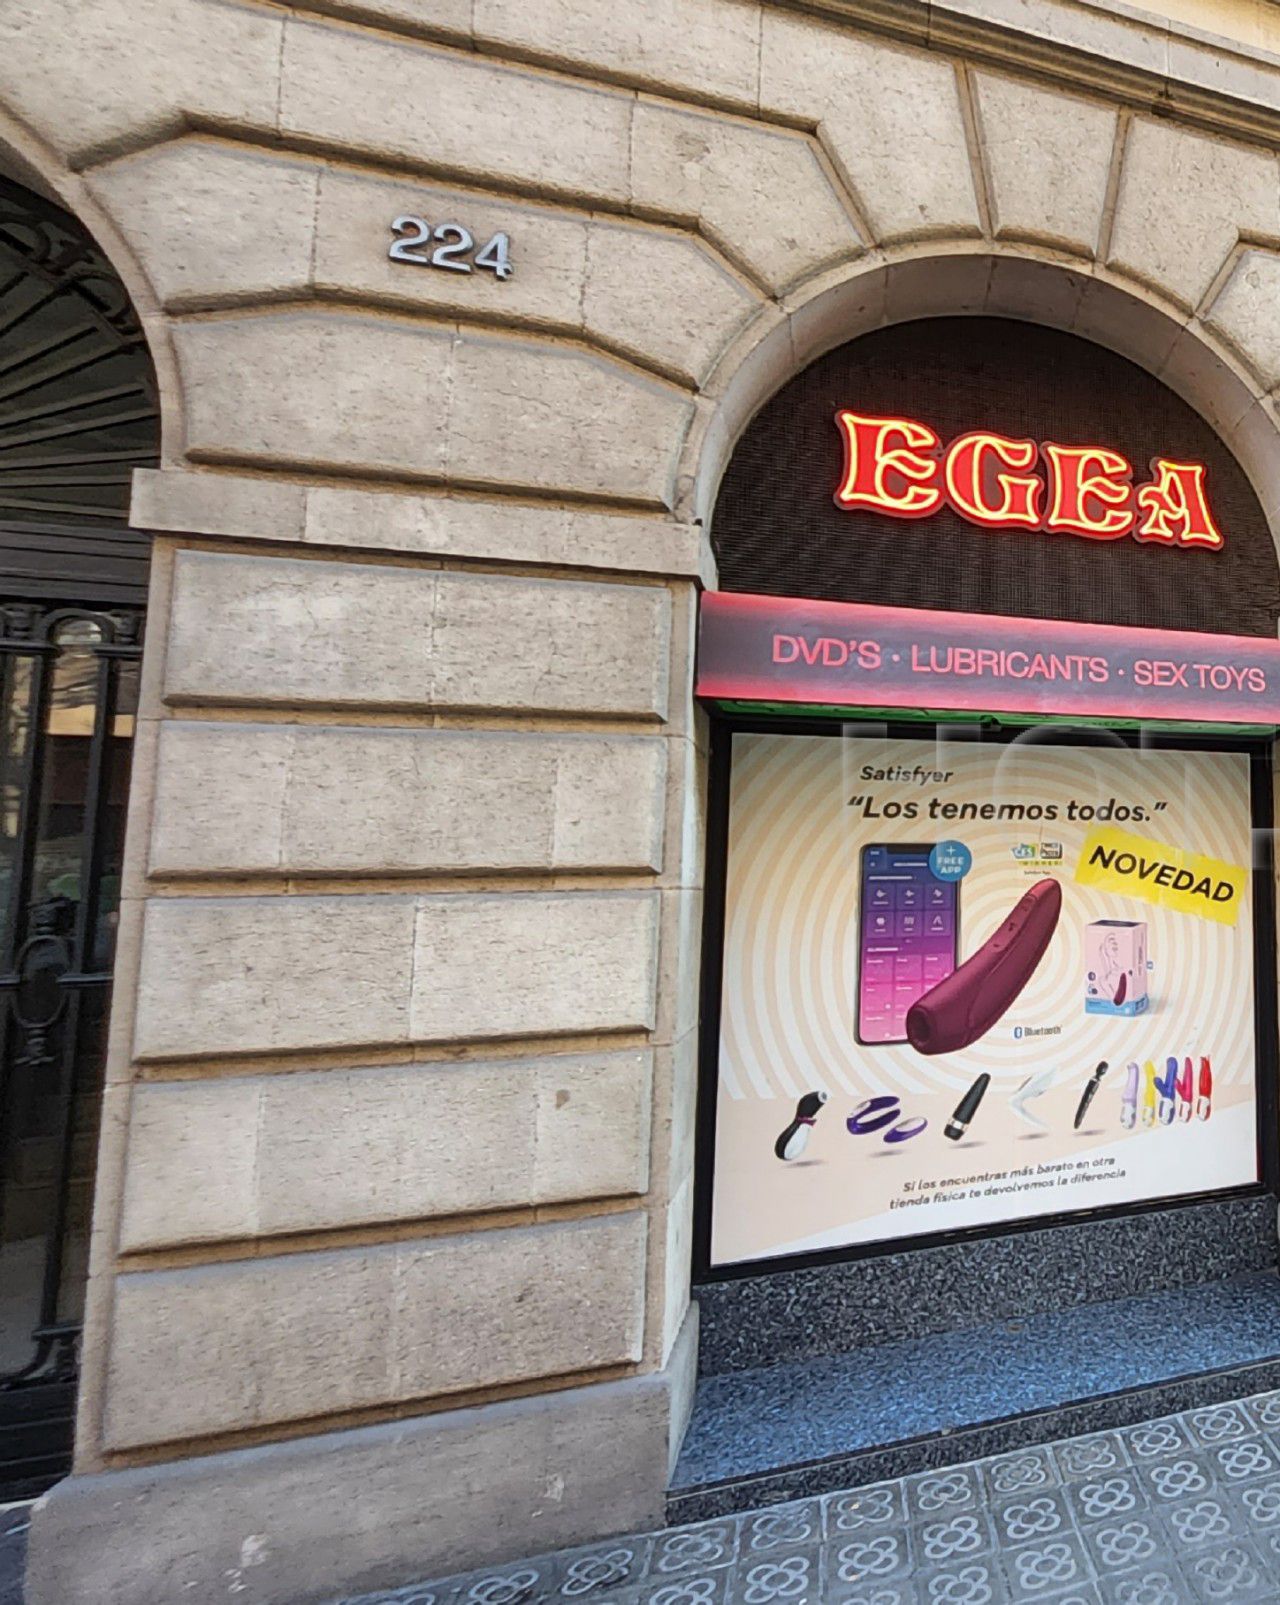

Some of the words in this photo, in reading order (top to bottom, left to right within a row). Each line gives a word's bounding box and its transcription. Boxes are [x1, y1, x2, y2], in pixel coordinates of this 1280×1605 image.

[388, 213, 514, 282] 224
[835, 409, 1225, 550] EGEA
[772, 634, 882, 671] DVD’S
[911, 644, 1109, 683] LUBRICANTS
[1133, 659, 1189, 689] SEX
[1193, 664, 1267, 693] TOYS
[860, 765, 954, 786] Satisfyer
[847, 796, 919, 819] “Los
[928, 798, 1059, 821] tenemos
[1067, 799, 1167, 822] todos.”
[937, 857, 964, 866] FREE
[940, 866, 962, 875] APP
[1088, 844, 1235, 903] NOVEDAD
[1024, 1026, 1061, 1037] Bluetooth
[889, 1193, 930, 1210] tienda
[932, 1190, 966, 1205] física
[968, 1188, 981, 1199] te
[983, 1179, 1055, 1196] devolvemos
[1057, 1174, 1068, 1187] la
[1070, 1167, 1127, 1185] diferencia
[903, 1180, 915, 1193] Si
[918, 1179, 937, 1191] los
[940, 1171, 1008, 1187] encuentras
[1010, 1164, 1034, 1180] más
[1036, 1160, 1074, 1175] barato
[1076, 1159, 1090, 1170] en
[1092, 1156, 1116, 1168] otra
